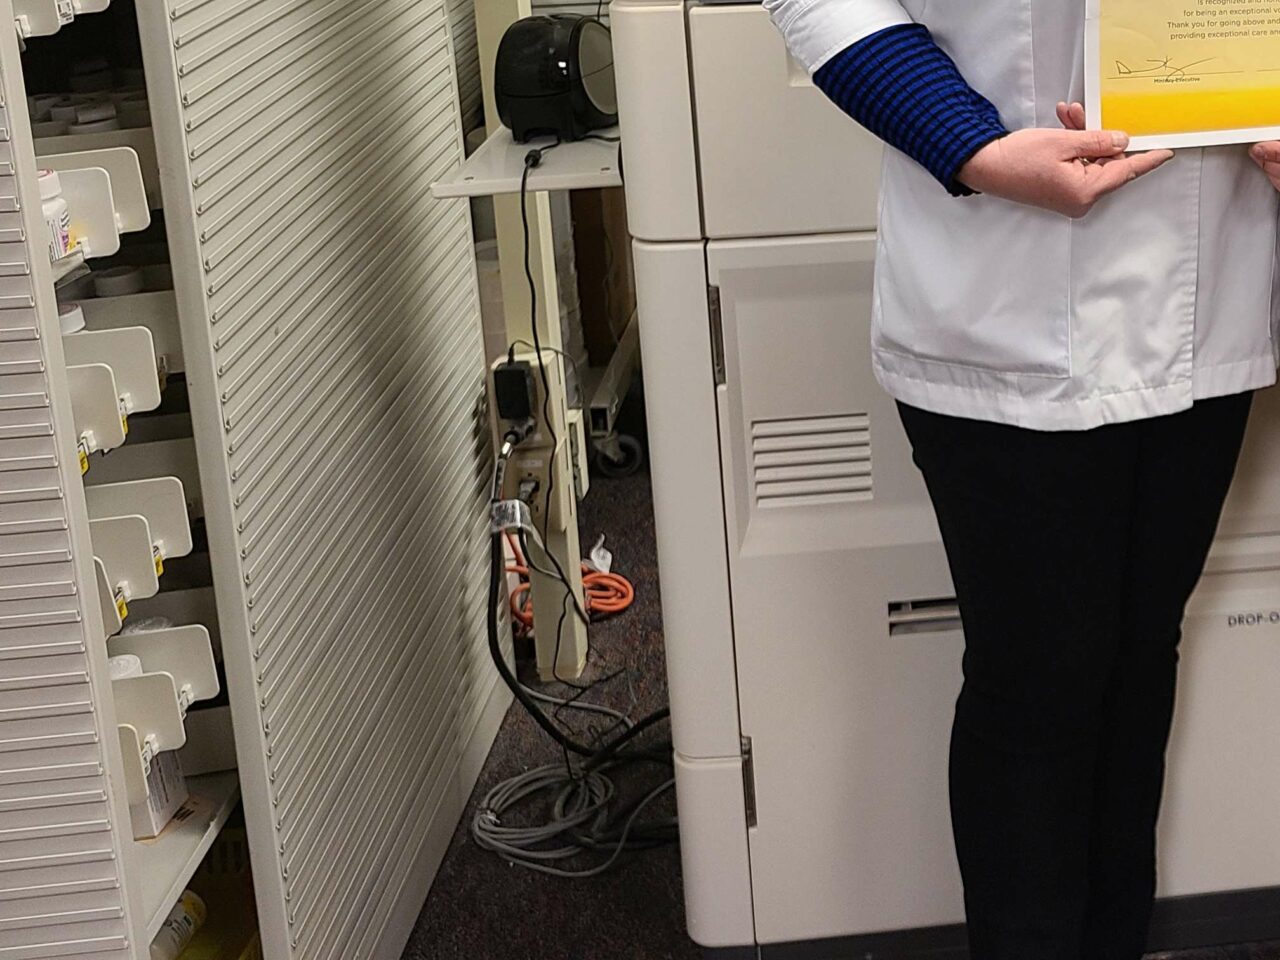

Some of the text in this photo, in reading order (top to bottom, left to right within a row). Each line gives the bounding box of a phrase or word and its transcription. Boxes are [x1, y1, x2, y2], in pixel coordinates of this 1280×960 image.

[1196, 8, 1217, 18] being
[1230, 7, 1272, 16] exceptional
[1167, 21, 1190, 29] Thank
[1191, 22, 1206, 30] you
[1207, 20, 1218, 28] for
[1220, 20, 1241, 28] going
[1242, 18, 1266, 26] above
[1170, 32, 1206, 41] providing
[1208, 29, 1250, 38] exceptional
